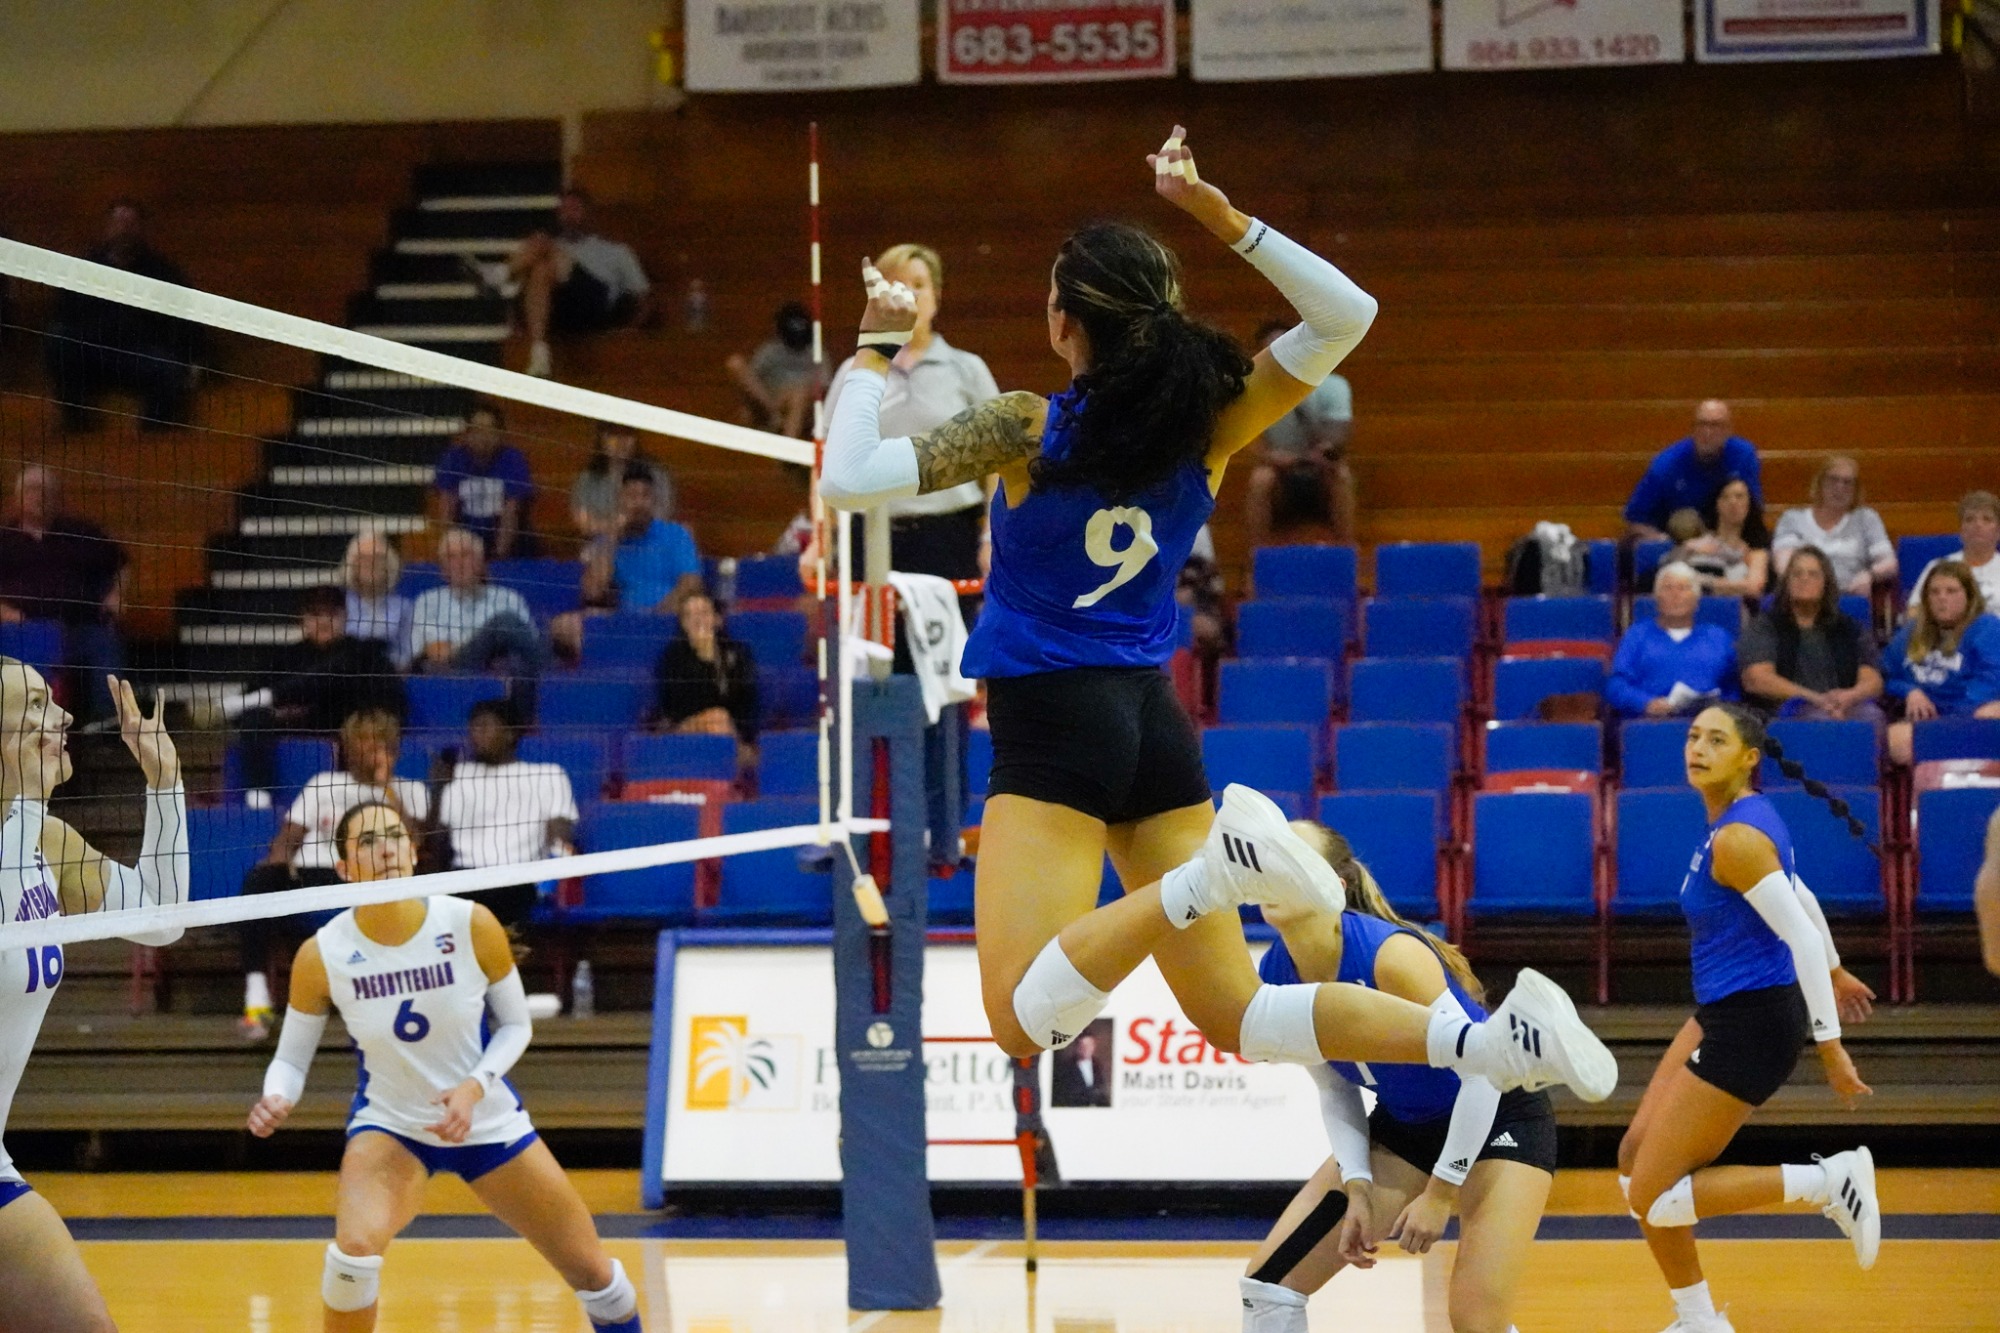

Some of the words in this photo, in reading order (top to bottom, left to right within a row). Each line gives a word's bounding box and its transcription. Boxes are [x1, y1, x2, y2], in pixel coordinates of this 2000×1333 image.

[953, 20, 1161, 66] 683-5535
[1072, 505, 1159, 609] 9
[352, 961, 455, 1000] PRESBYTERIAN
[393, 998, 431, 1043] 6
[1122, 1070, 1175, 1090] Matt
[1184, 1069, 1247, 1090] Davis
[1490, 1140, 1519, 1148] adidas
